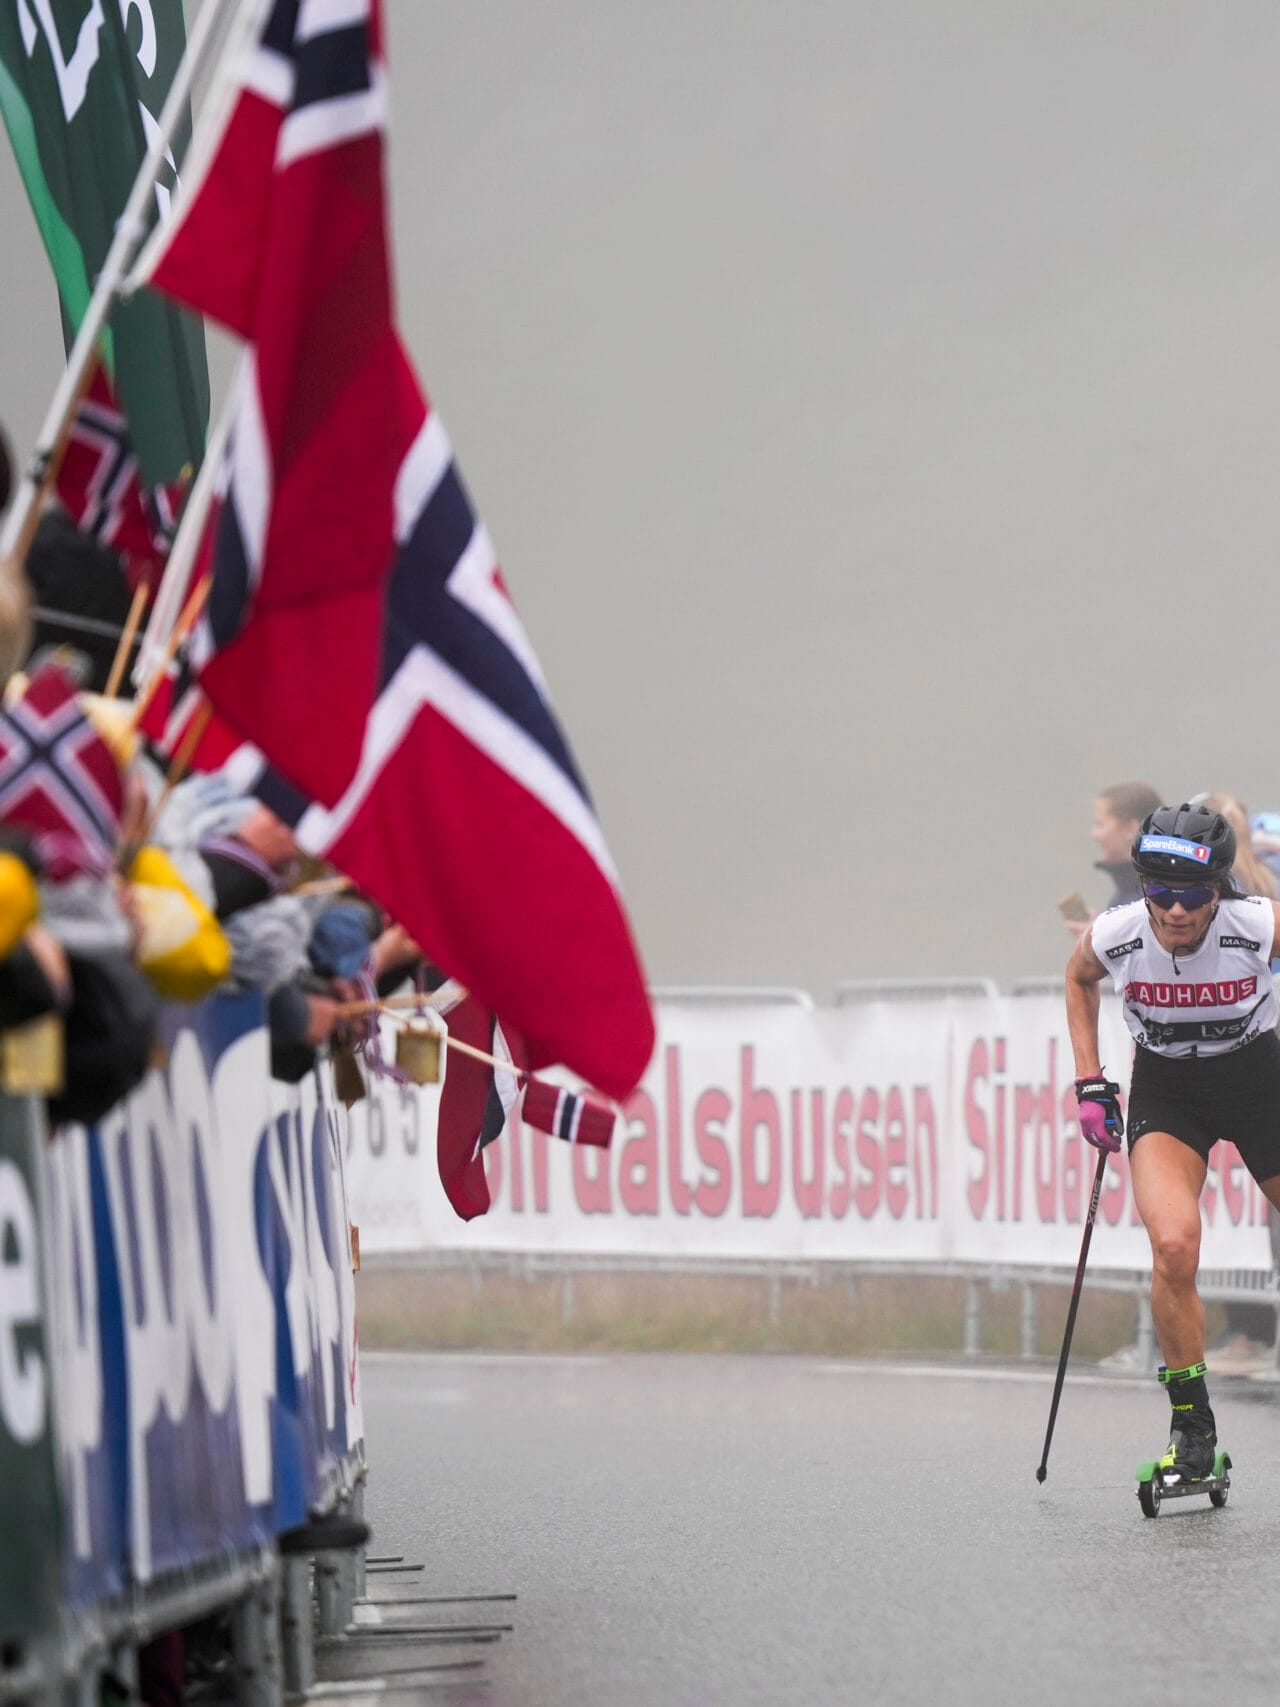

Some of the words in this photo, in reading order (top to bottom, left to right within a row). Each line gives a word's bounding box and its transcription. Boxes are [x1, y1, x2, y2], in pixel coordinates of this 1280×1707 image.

[1143, 838, 1194, 855] SpareBank
[1222, 936, 1258, 950] MASIV
[484, 1044, 937, 1220] ialsbussen
